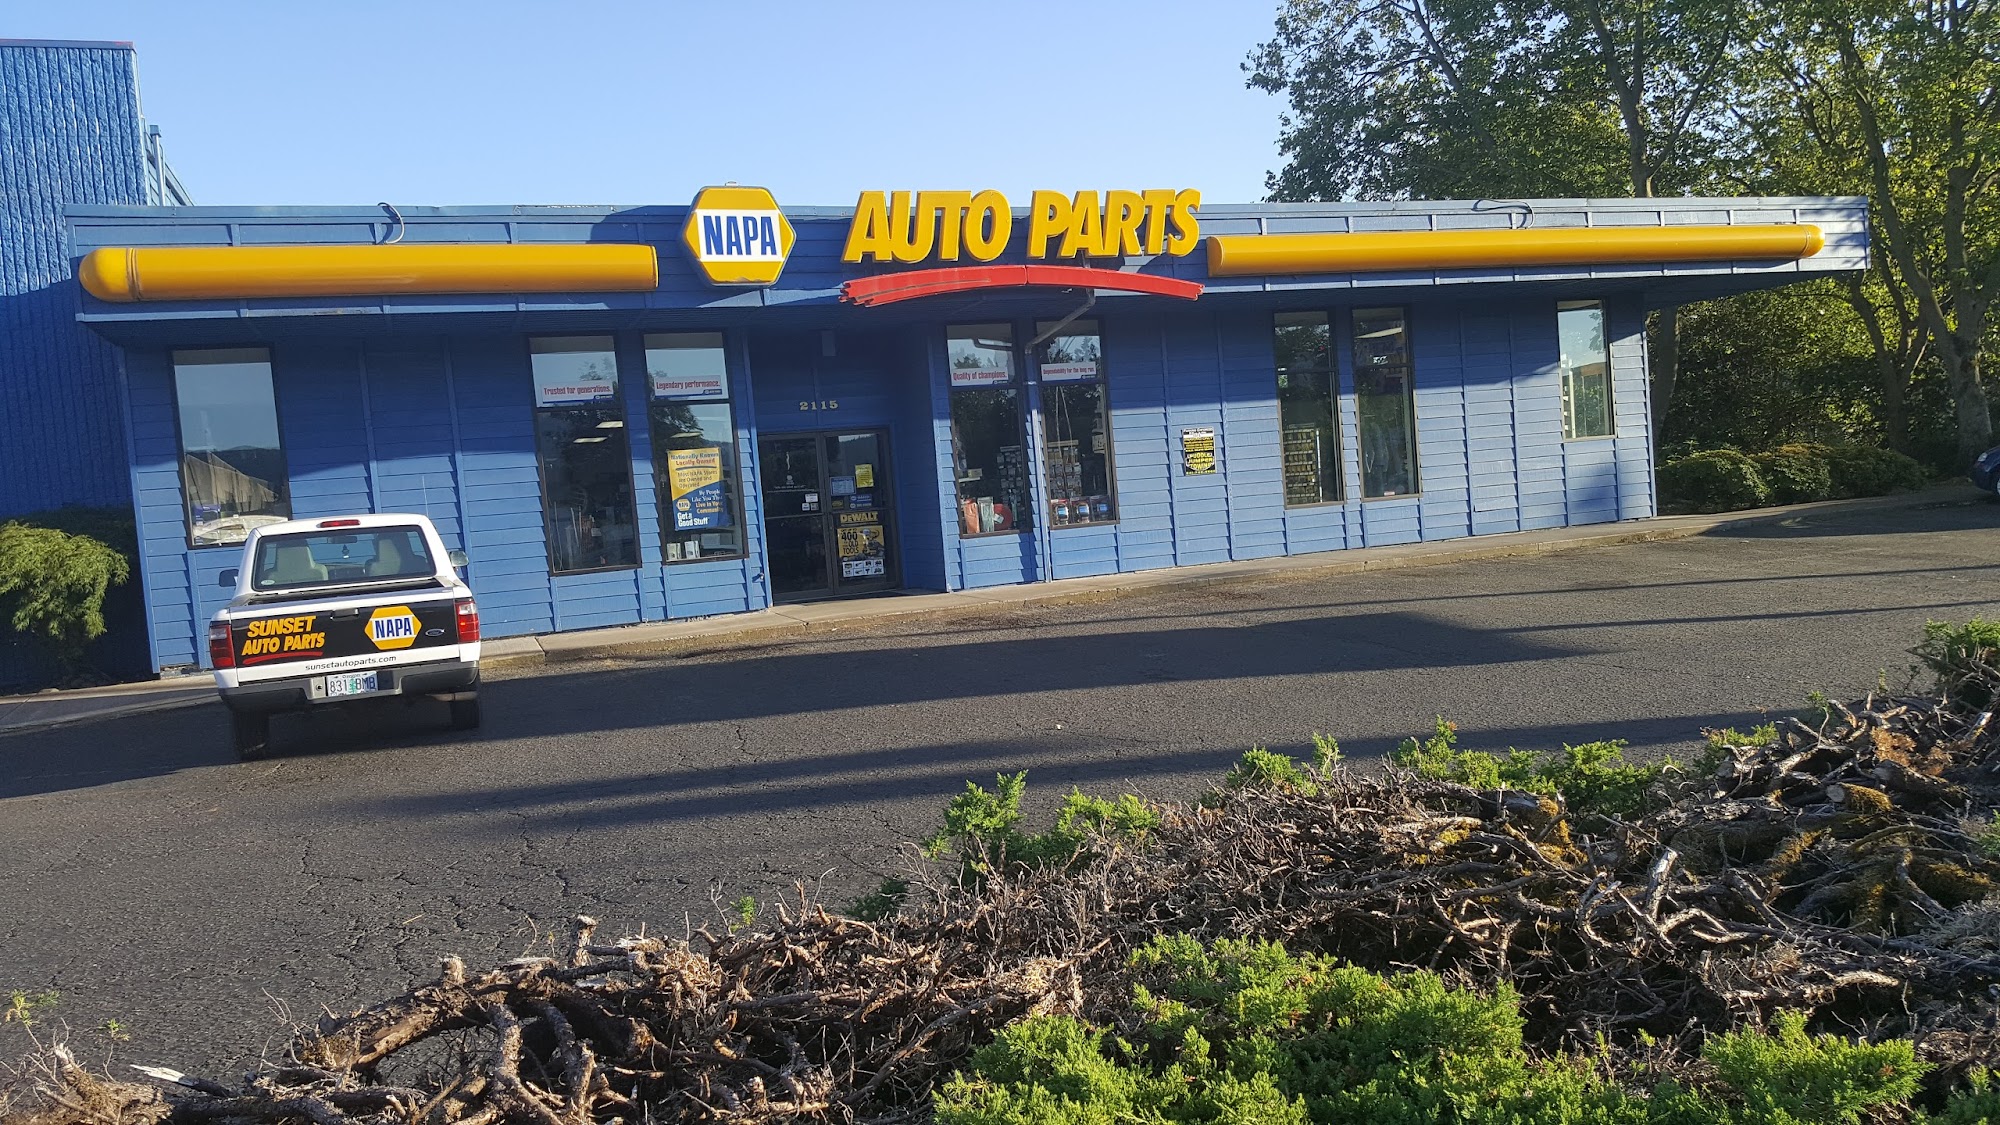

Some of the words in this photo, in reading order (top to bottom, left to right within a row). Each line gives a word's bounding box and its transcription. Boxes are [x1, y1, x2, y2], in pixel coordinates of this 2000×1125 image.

[842, 189, 1012, 263] AUTO
[1027, 188, 1201, 259] PARTS
[703, 215, 777, 256] NAPA
[953, 372, 971, 381] Quality
[544, 387, 565, 395] Trusted
[577, 385, 611, 394] generations.
[657, 381, 683, 390] Legendary
[684, 380, 720, 389] performance.
[800, 400, 838, 410] 2115
[247, 615, 316, 638] SUNSET
[375, 617, 413, 639] NAPA
[242, 637, 280, 655] AUTO
[284, 632, 325, 652] PARTS
[305, 655, 396, 671] sunsetautoparts.com
[330, 680, 348, 693] 831
[355, 677, 376, 690] BMB
